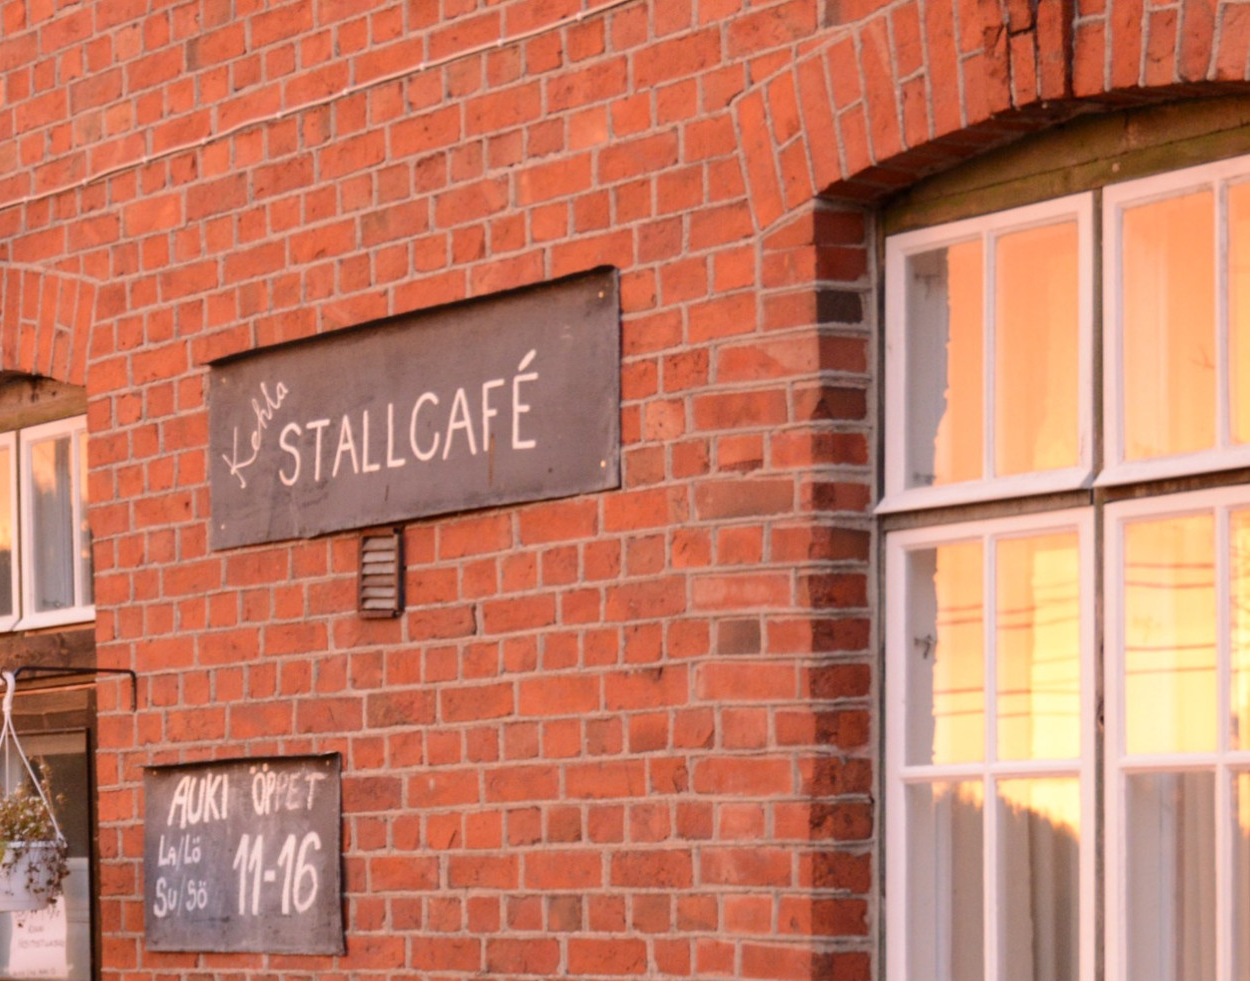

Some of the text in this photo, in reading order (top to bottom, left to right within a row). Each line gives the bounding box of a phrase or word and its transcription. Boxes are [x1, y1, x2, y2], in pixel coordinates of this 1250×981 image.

[278, 349, 539, 487] STALLCAFÉ
[167, 763, 327, 829] AUKI ÖPPET
[232, 831, 321, 917] 11-16
